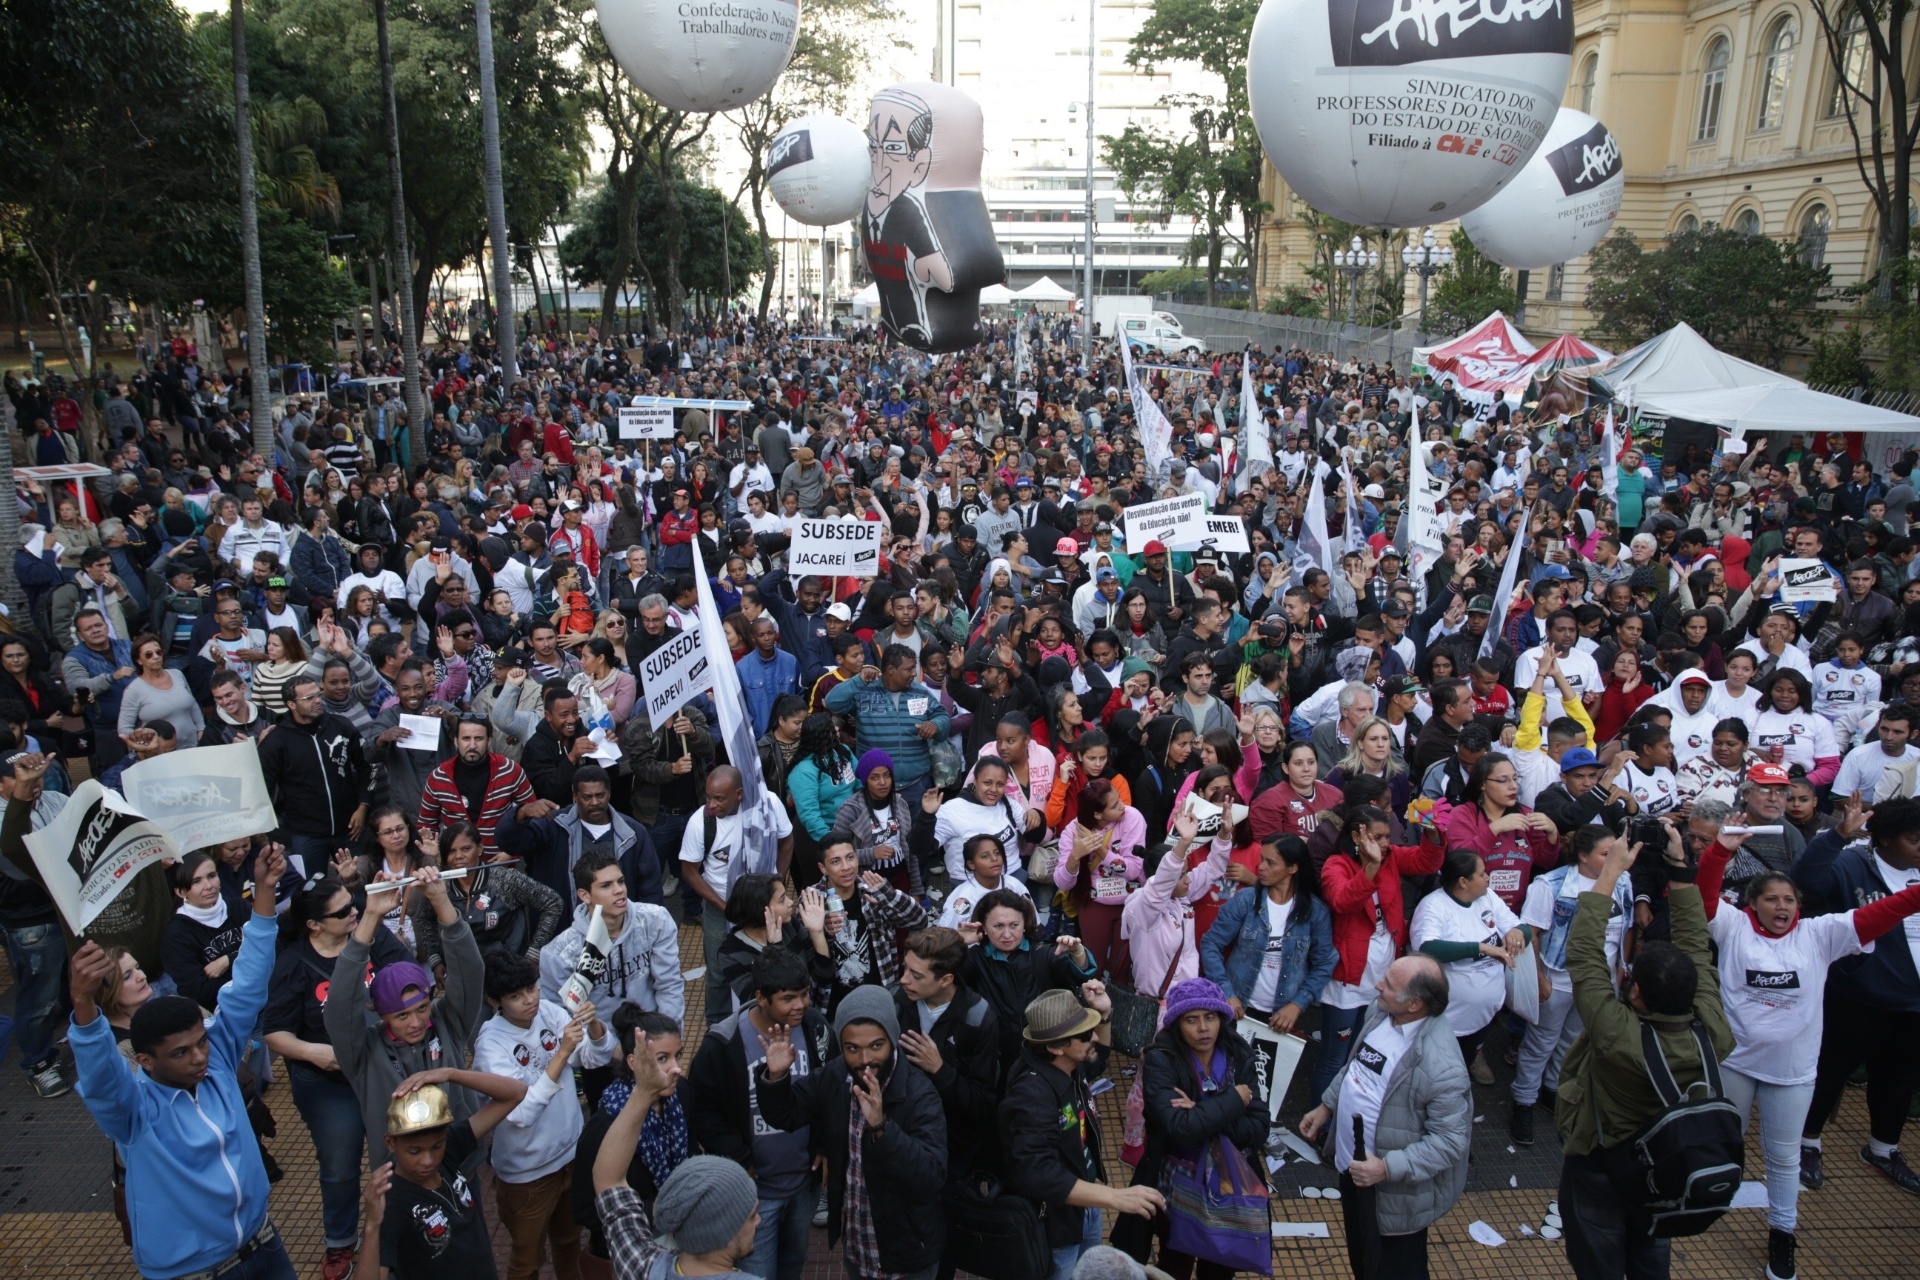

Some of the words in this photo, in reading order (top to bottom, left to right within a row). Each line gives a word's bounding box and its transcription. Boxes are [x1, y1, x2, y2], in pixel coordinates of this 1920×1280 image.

[678, 3, 768, 23] Confederação
[679, 20, 767, 39] Trabalhadores
[769, 31, 784, 42] em
[1406, 79, 1506, 105] SINDICATO
[1508, 93, 1536, 112] DOS
[1317, 96, 1447, 114] PROFESSORES
[1451, 102, 1478, 118] DO
[1480, 107, 1530, 130] ENSINO
[1352, 113, 1378, 126] DO
[1383, 114, 1453, 132] ESTADO
[1456, 120, 1478, 135] DE
[1482, 123, 1511, 142] SÃO
[1368, 133, 1419, 150] Filiado
[1422, 137, 1431, 150] à
[1482, 149, 1490, 158] e
[1126, 503, 1168, 520] Desvinculação
[1169, 501, 1180, 510] das
[1181, 497, 1201, 509] verbas
[801, 522, 875, 540] SUBSEDE
[1139, 521, 1147, 531] da
[1177, 512, 1191, 523] não!
[1207, 521, 1240, 533] EMER!
[796, 551, 847, 565] JACAREÍ
[646, 629, 701, 682] SUBSEDE
[652, 679, 684, 715] ITAPEVI
[88, 883, 111, 905] Filiado
